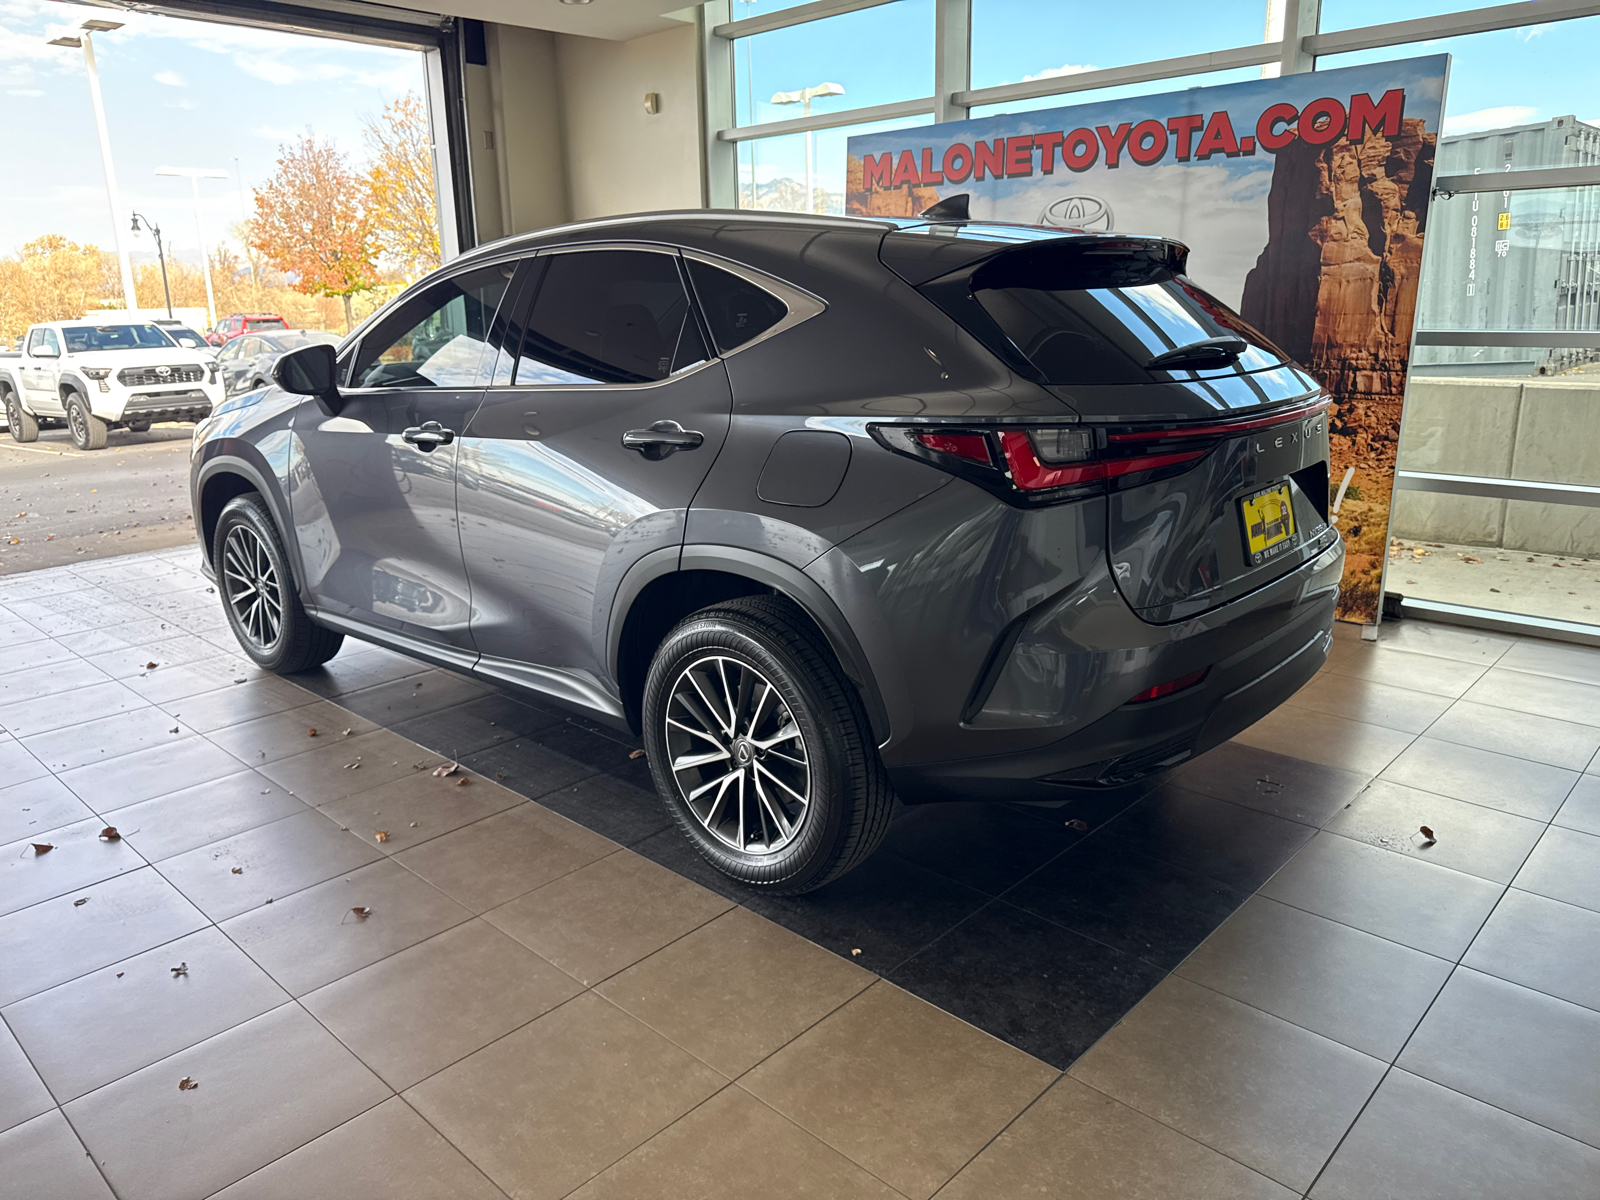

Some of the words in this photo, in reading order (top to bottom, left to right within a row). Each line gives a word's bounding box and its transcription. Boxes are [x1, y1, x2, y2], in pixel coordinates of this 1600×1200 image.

[862, 88, 1406, 192] MALONETOYOTA.COM
[1469, 215, 1478, 280] 081884
[1256, 423, 1322, 453] LEXUS
